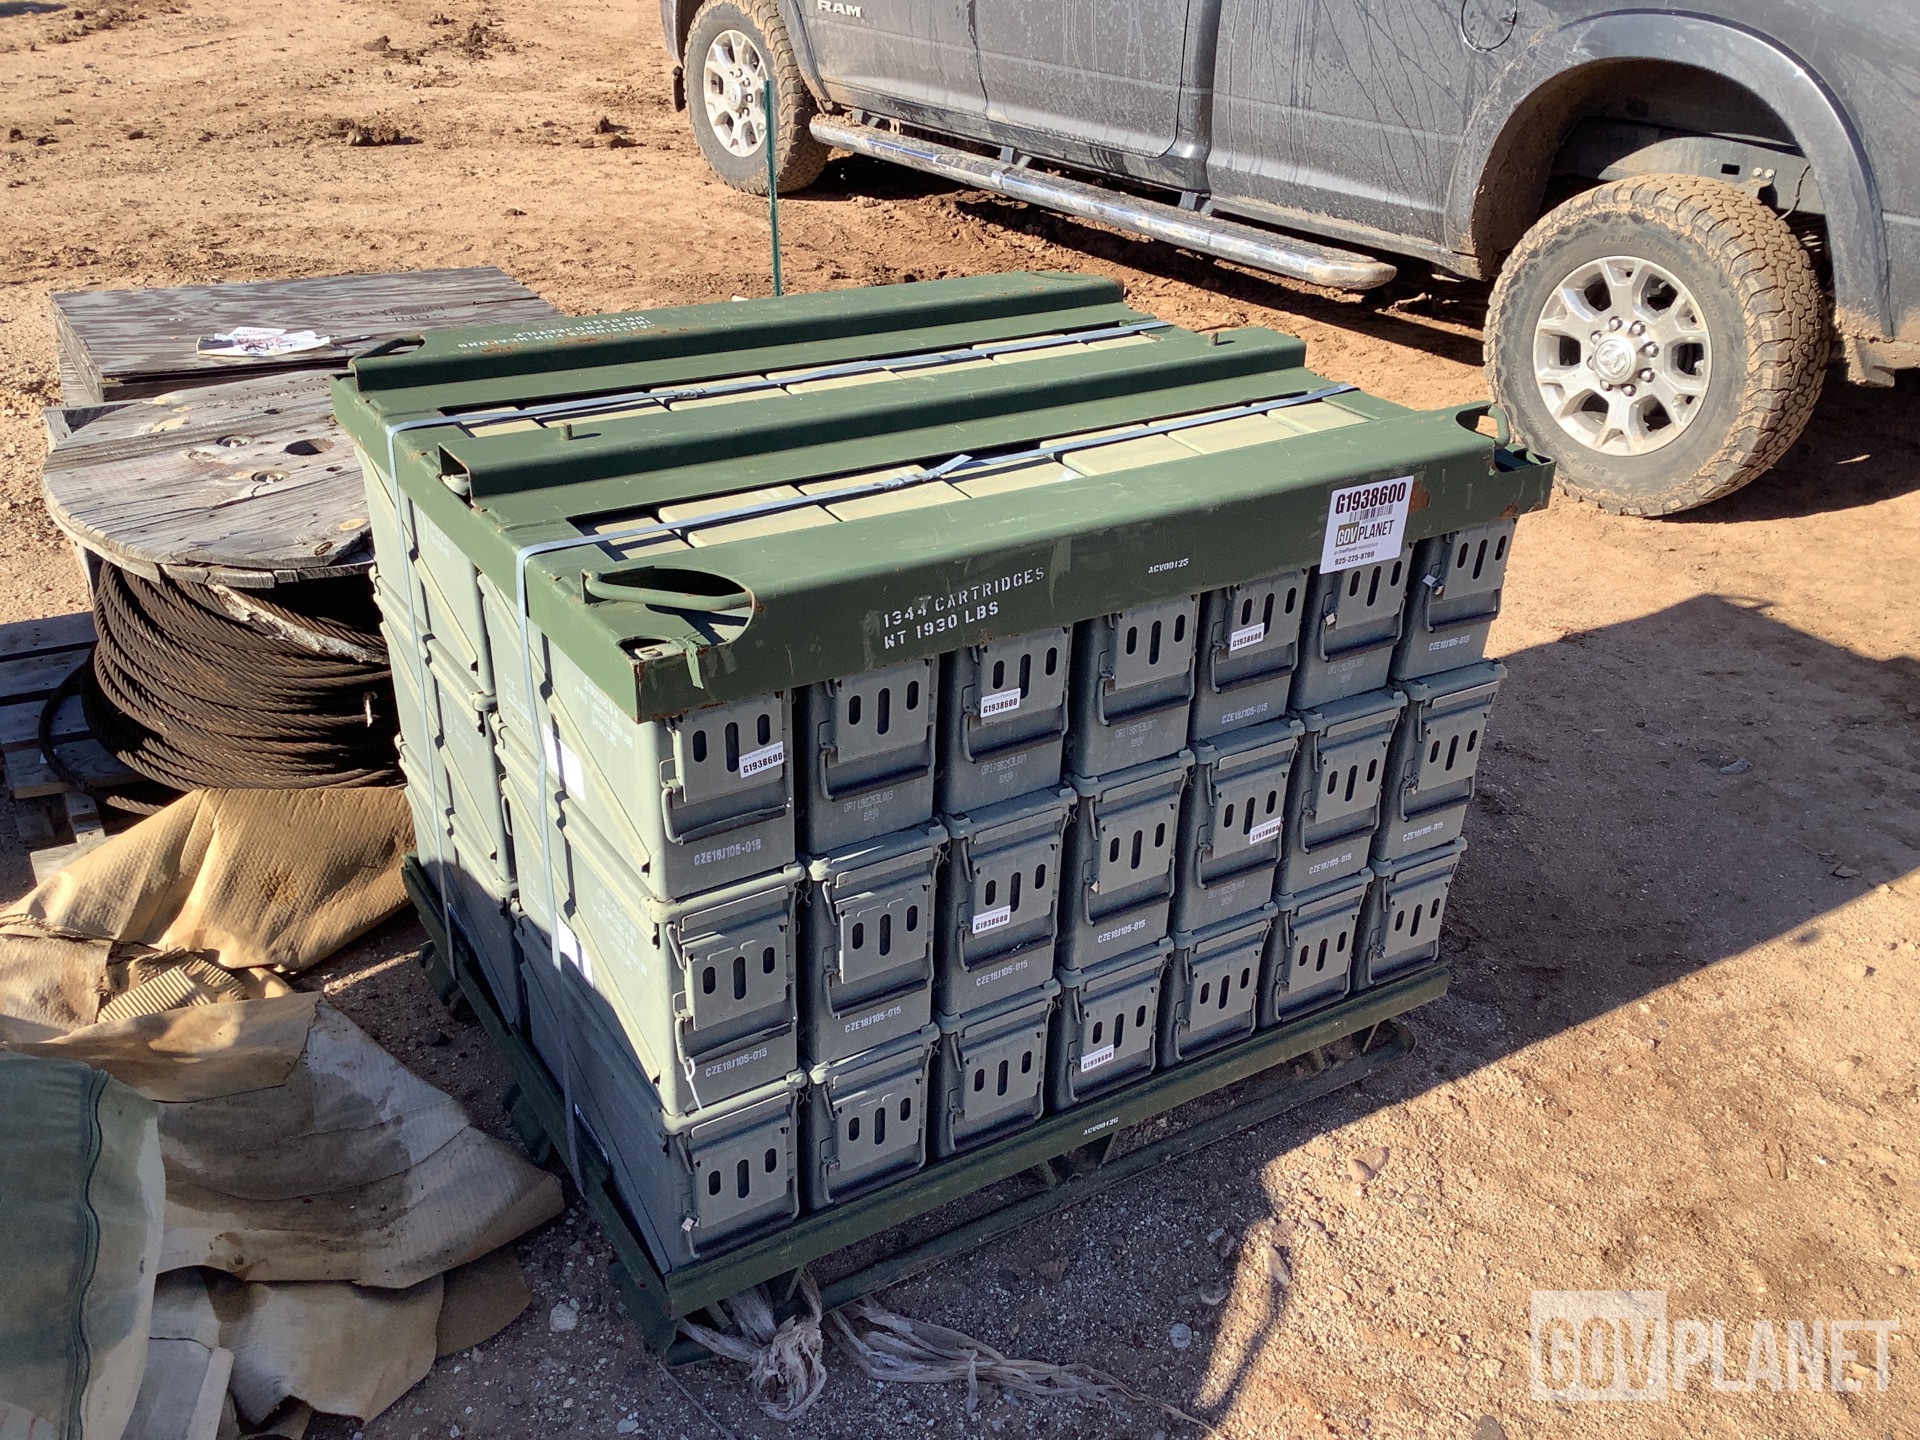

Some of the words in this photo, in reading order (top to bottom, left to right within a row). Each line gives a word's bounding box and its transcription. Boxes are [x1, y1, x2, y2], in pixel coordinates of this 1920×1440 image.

[817, 1, 862, 18] RAM
[1335, 482, 1407, 515] G1938600
[1148, 557, 1189, 573] ACV00125
[935, 566, 1045, 612] CARTRIDGES
[916, 613, 958, 639] 1930
[965, 601, 999, 624] LBS
[983, 698, 1018, 714] G1938600
[743, 752, 783, 773] G1938600
[975, 914, 1008, 930] G1938600
[976, 959, 1029, 987] CZE18J105-015
[844, 1005, 902, 1034] CZE18J105-015
[705, 1047, 768, 1078] CZE18J105-015
